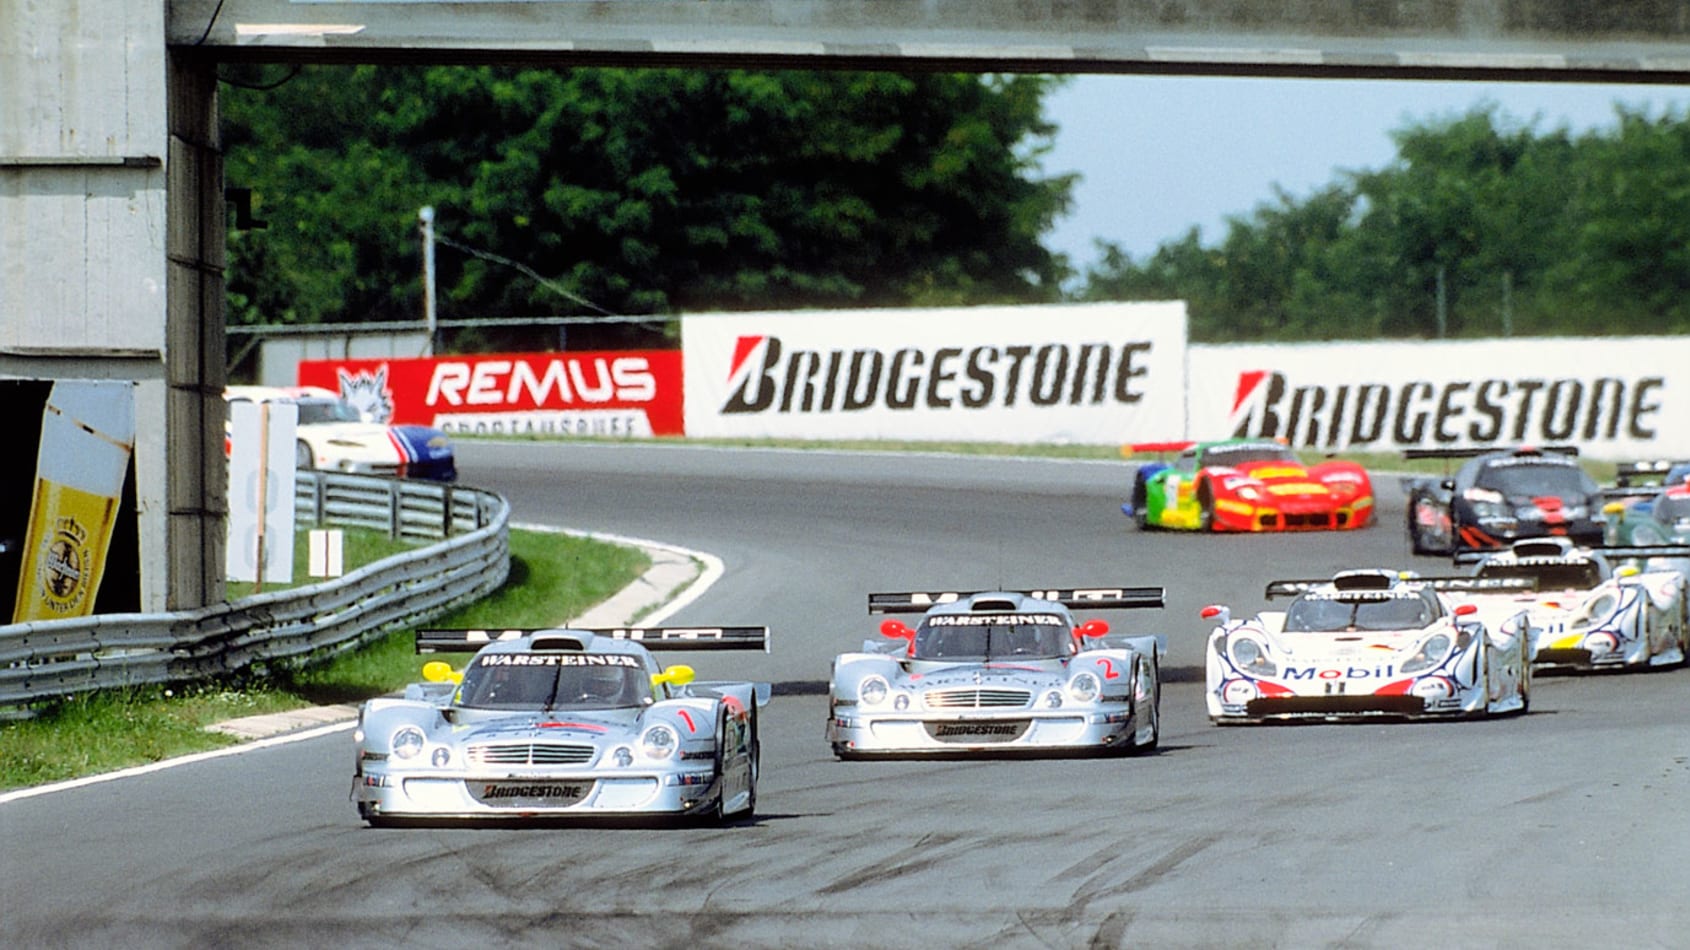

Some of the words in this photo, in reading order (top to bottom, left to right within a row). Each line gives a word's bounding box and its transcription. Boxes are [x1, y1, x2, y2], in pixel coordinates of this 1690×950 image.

[426, 357, 656, 406] REMUS
[720, 335, 1153, 414] BRIDGESTONE
[1232, 370, 1664, 447] BRIDGESTONE
[930, 614, 1063, 626] WARSTEINER
[481, 655, 639, 667] WARSTEINER
[1096, 657, 1120, 680] 2
[1282, 665, 1393, 680] Mobil
[677, 709, 696, 733] 1
[936, 725, 1017, 737] BRIDGESTONE
[483, 785, 581, 799] BRIDGESTONE
